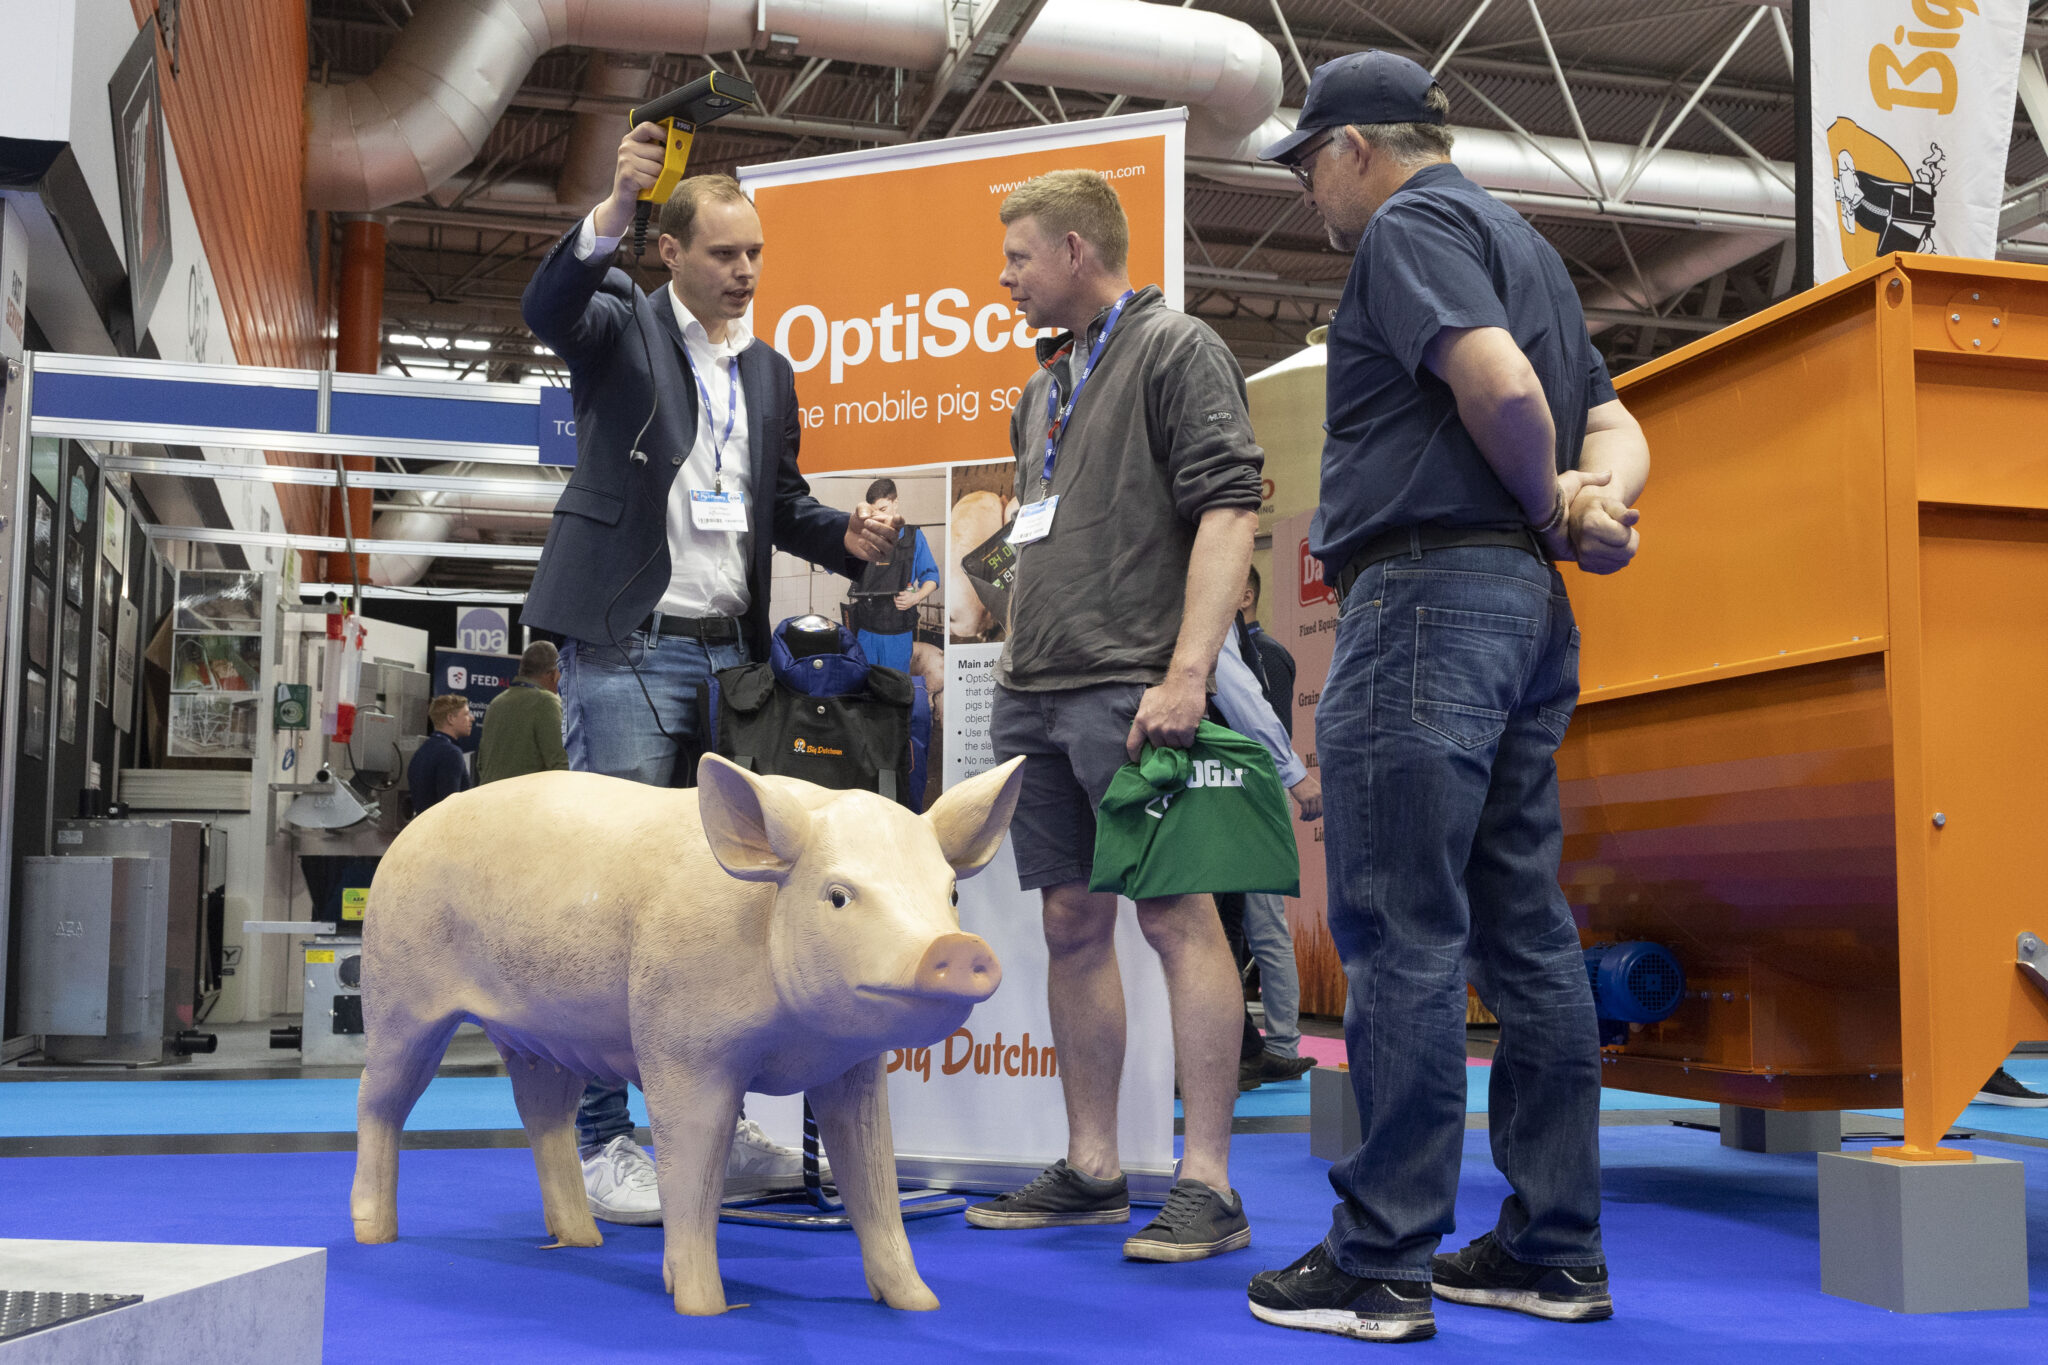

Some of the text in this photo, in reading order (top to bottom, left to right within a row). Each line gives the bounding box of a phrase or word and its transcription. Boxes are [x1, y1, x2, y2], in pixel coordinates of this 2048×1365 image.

[774, 287, 1069, 384] OptiSca
[834, 390, 928, 425] mobile
[937, 384, 980, 424] pig
[460, 628, 506, 654] npa
[958, 660, 981, 669] Main
[965, 687, 981, 696] that
[965, 700, 982, 711] pigs
[965, 728, 981, 738] Use
[964, 742, 978, 751] the
[964, 756, 977, 765] No
[1360, 1320, 1380, 1331] FILA
